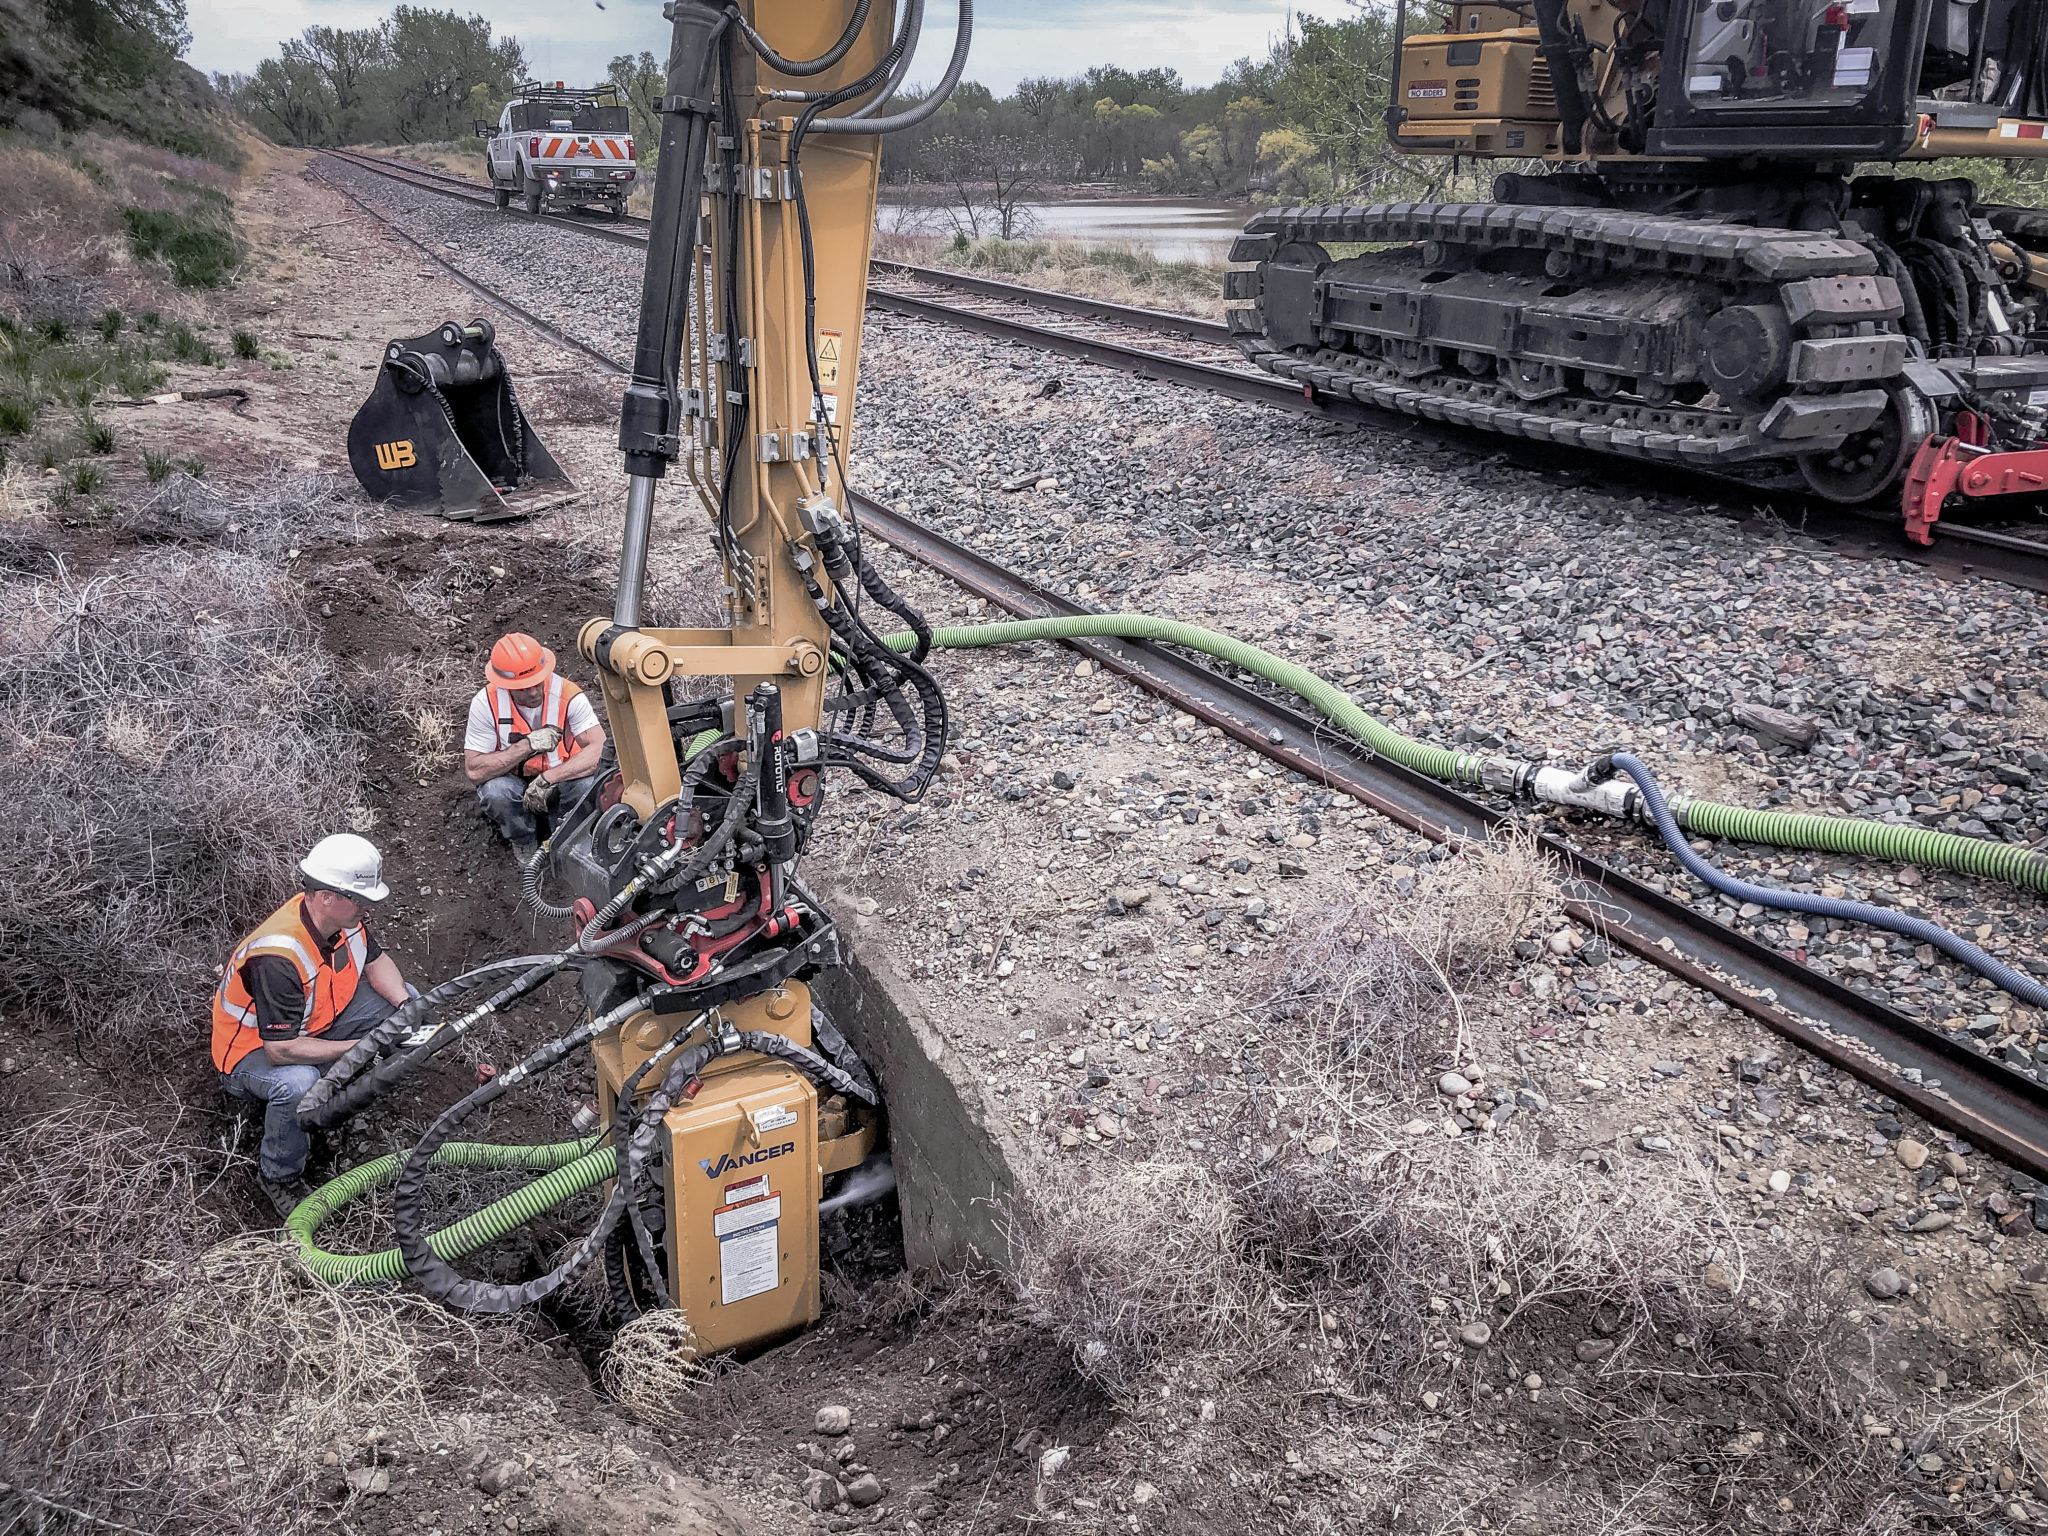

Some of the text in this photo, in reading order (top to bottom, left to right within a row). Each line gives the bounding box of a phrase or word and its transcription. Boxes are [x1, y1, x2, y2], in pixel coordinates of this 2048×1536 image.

[1422, 89, 1444, 97] RIDERS
[773, 745, 784, 794] ROTOTILT
[698, 1141, 795, 1179] VANCER
[732, 1224, 766, 1238] INSTRUCTION
